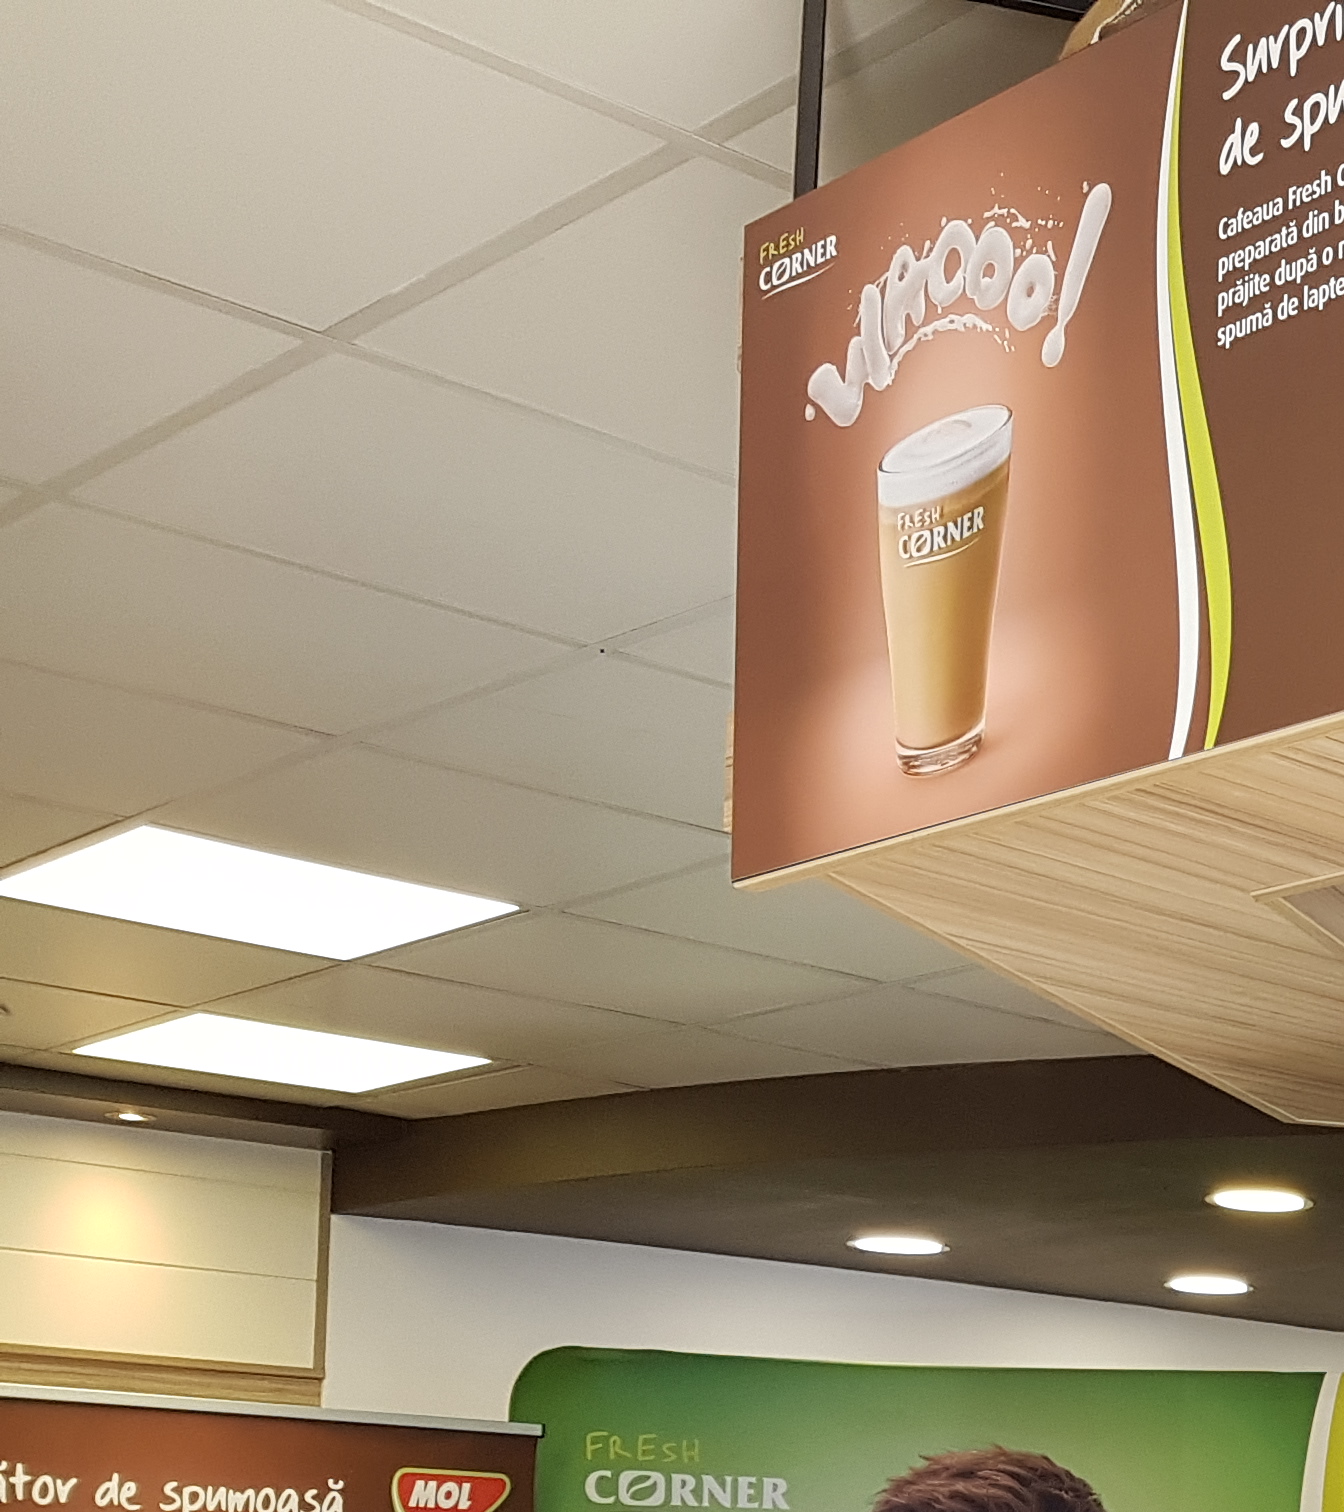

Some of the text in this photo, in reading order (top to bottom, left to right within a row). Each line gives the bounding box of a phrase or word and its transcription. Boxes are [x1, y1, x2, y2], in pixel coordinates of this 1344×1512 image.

[1219, 117, 1264, 175] de
[1218, 197, 1283, 240] Cafeaua
[1288, 170, 1332, 211] Fresh
[1218, 221, 1297, 282] preparată
[1302, 208, 1330, 239] din
[1218, 271, 1270, 317] prăjite
[1275, 247, 1317, 287] după
[1322, 247, 1333, 266] o
[1217, 303, 1273, 350] spumă
[1277, 294, 1298, 322] de
[584, 1431, 700, 1462] FRESH
[95, 1473, 141, 1511] de
[408, 1480, 472, 1510] MOL
